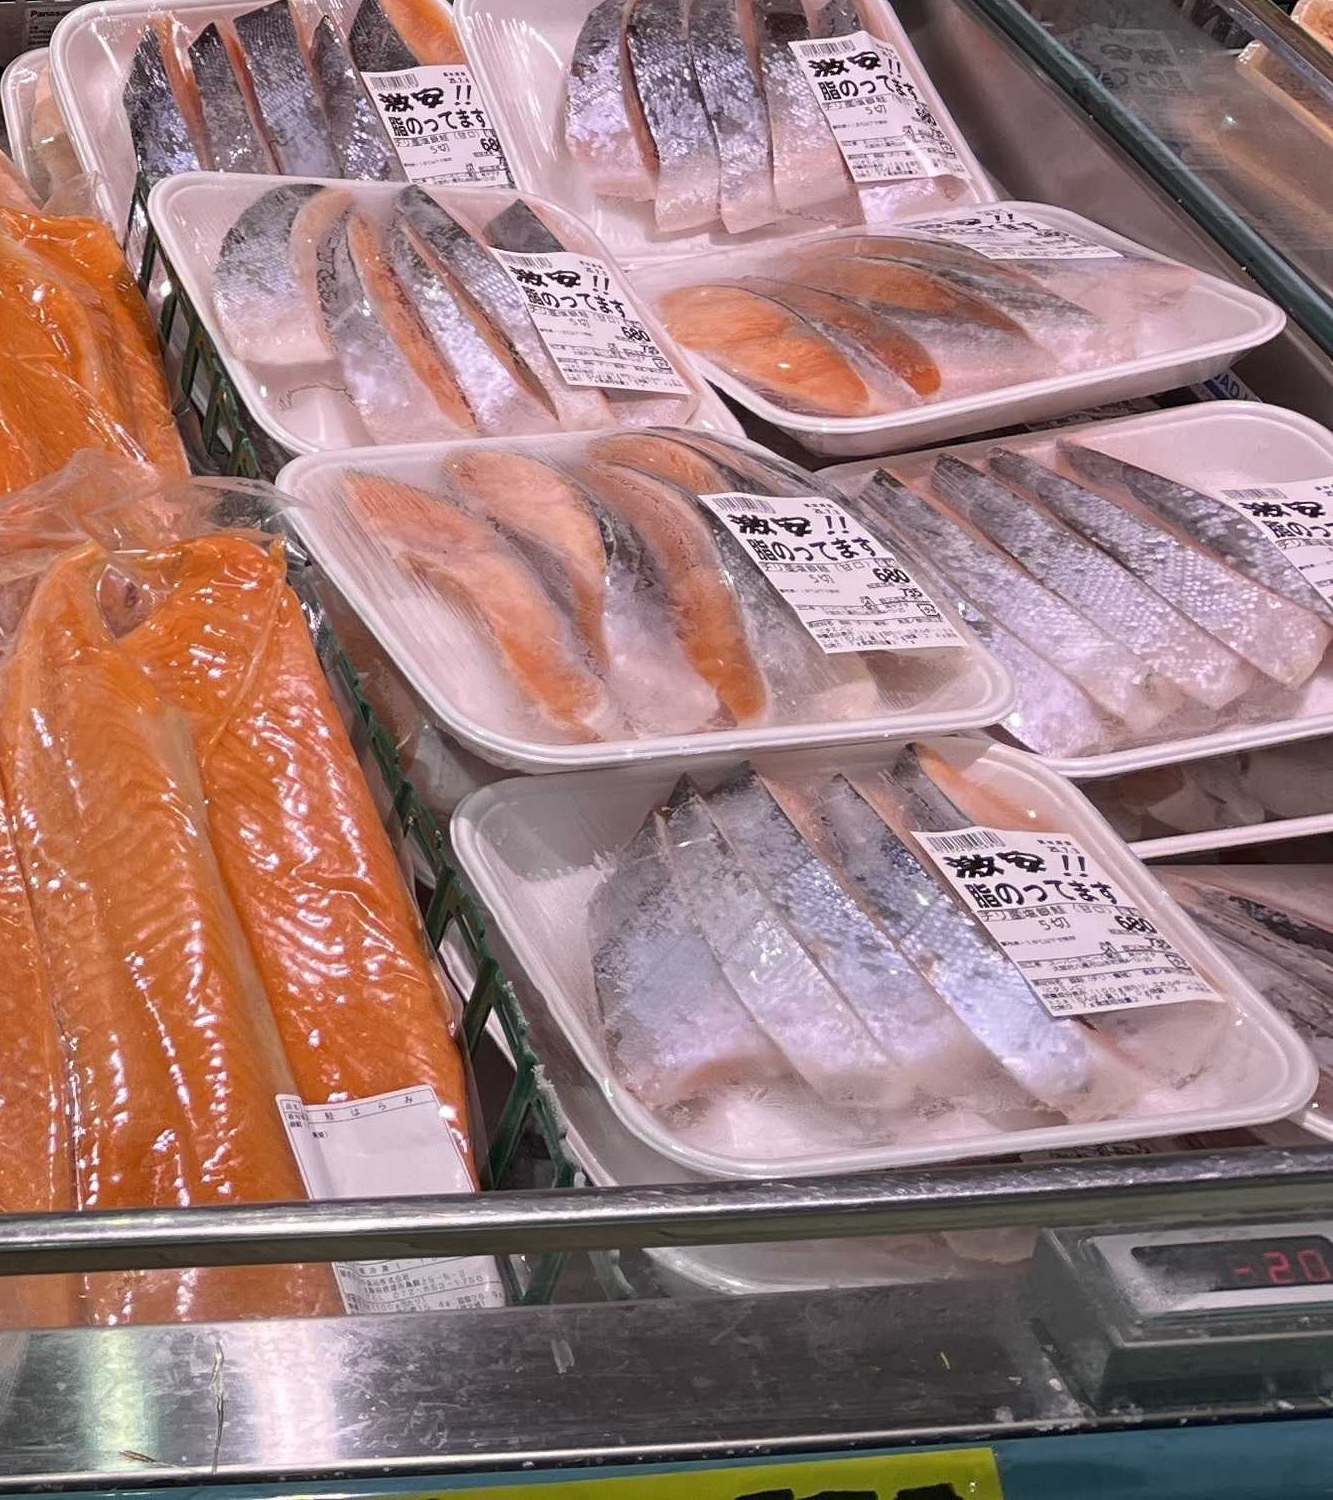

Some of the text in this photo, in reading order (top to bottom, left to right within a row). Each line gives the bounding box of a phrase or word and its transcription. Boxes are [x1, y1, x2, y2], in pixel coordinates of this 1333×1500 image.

[818, 75, 918, 101] 脂のってます
[390, 108, 486, 137] 脂のってます
[521, 285, 627, 318] 脂のってます
[746, 537, 877, 561] 脂のってます
[873, 566, 910, 584] 680
[965, 880, 1118, 909] 脂のってます
[1114, 914, 1158, 934] 680
